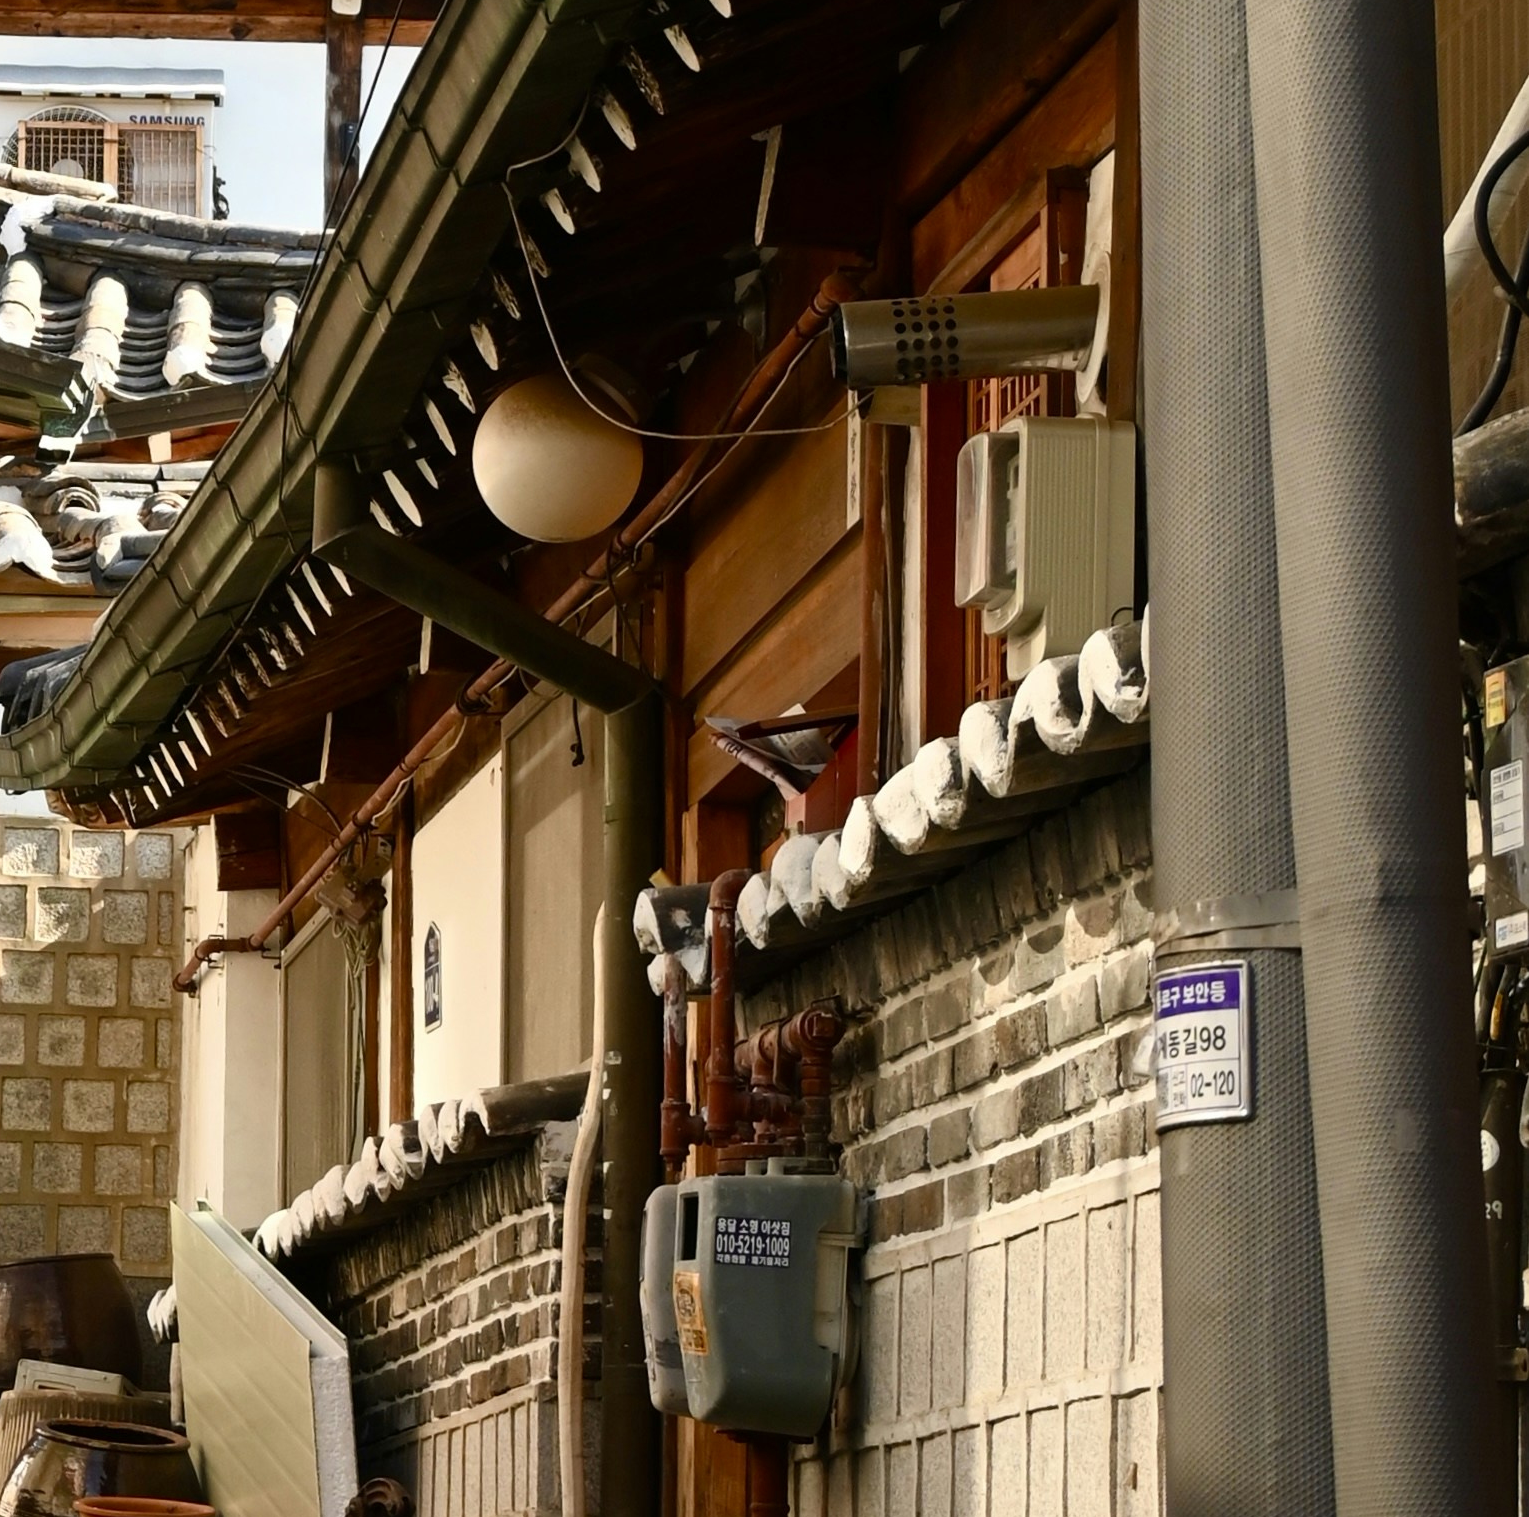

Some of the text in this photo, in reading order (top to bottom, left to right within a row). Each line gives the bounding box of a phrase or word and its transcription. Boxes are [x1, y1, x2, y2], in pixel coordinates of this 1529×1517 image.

[129, 114, 206, 127] SAMSUNG
[1182, 980, 1226, 1004] 보안등
[1190, 1069, 1236, 1099] 02-120
[717, 1217, 791, 1236] 용달 소형 이삿짐
